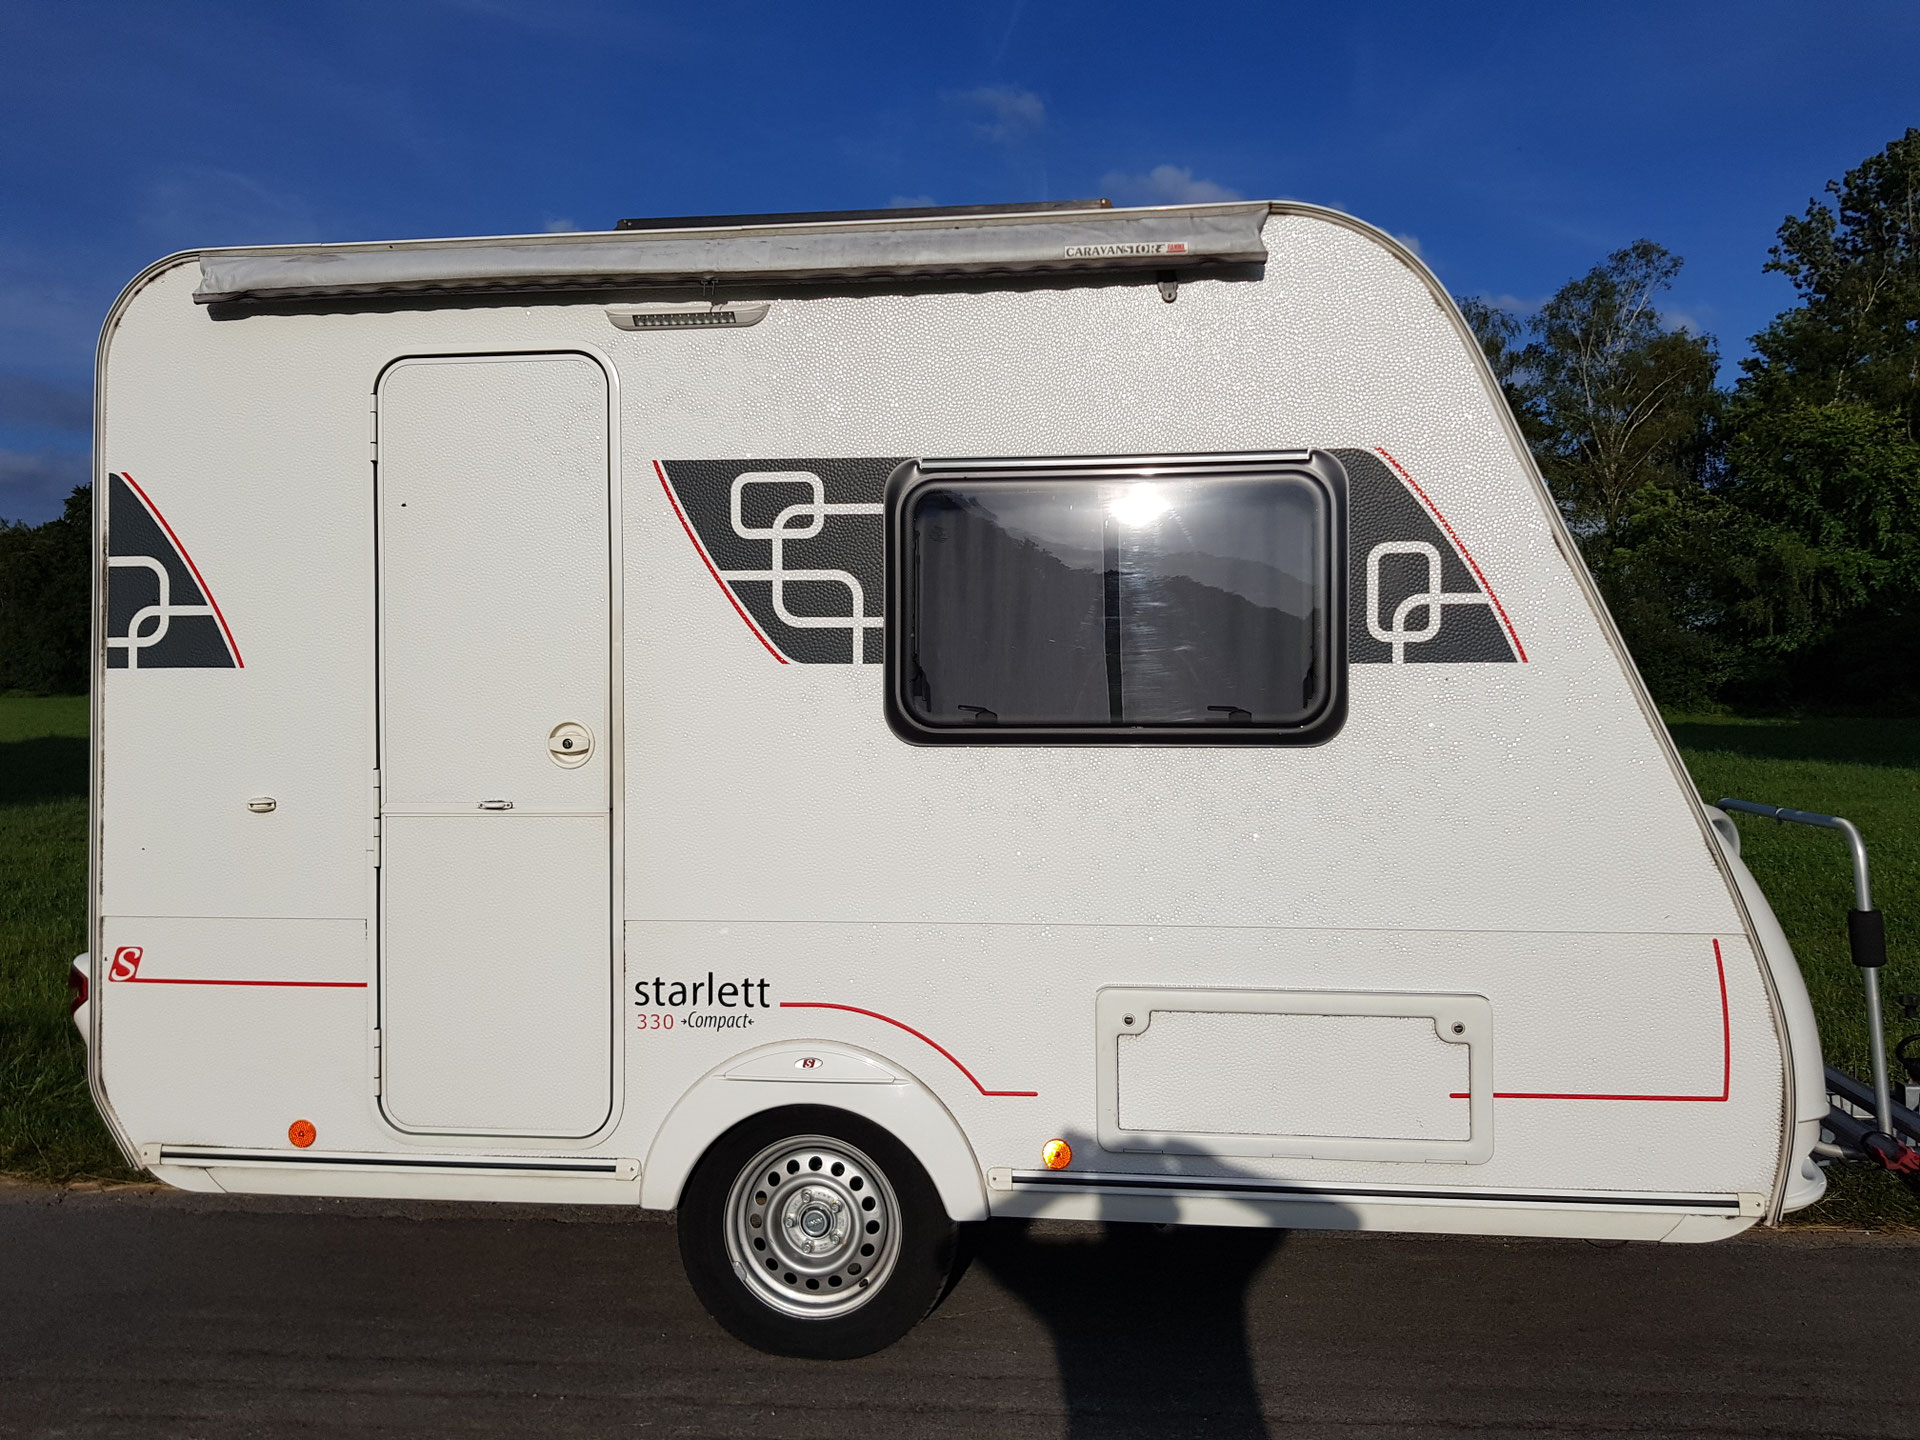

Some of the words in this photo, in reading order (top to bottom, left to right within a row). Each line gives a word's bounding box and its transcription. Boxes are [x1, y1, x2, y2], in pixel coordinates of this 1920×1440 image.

[634, 972, 770, 1008] starlett
[637, 1013, 674, 1030] 330
[688, 1011, 748, 1032] Compact
